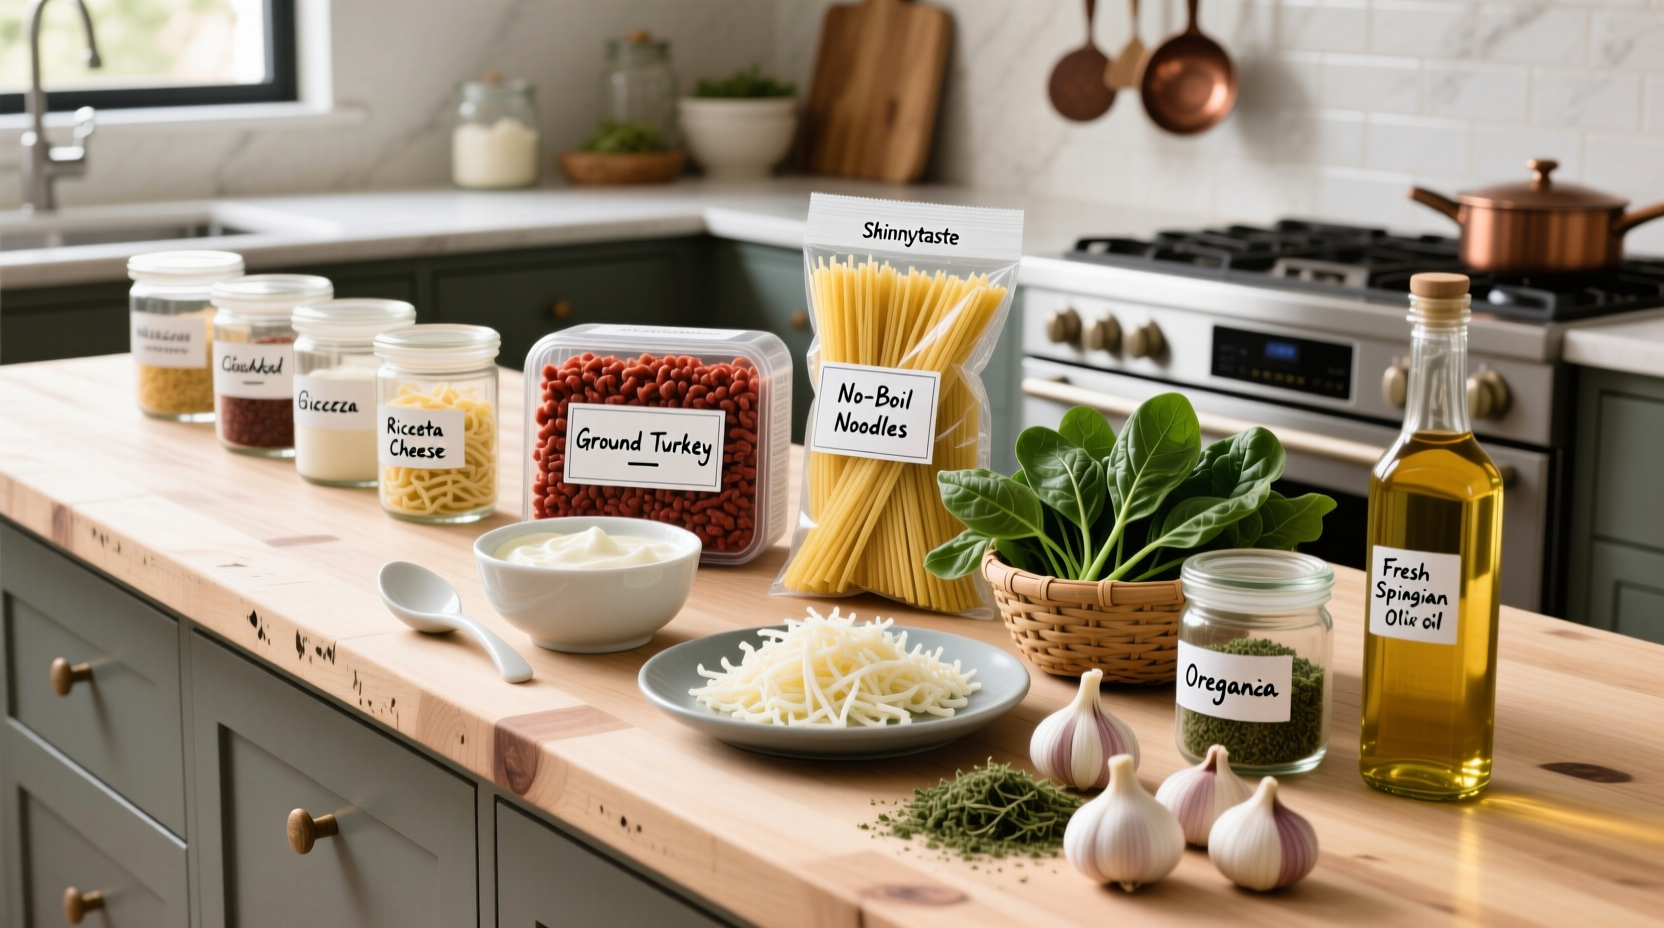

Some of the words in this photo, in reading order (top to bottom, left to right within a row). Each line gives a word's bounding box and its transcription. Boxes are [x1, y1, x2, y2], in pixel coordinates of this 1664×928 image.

[837, 382, 913, 410] No-Boil
[834, 411, 907, 438] Noodles
[390, 438, 447, 459] Cheese
[576, 427, 643, 451] Ground
[650, 431, 712, 467] Turkey
[1383, 557, 1430, 582] Fresh
[1375, 580, 1448, 608] Spingian
[1422, 611, 1443, 631] oil
